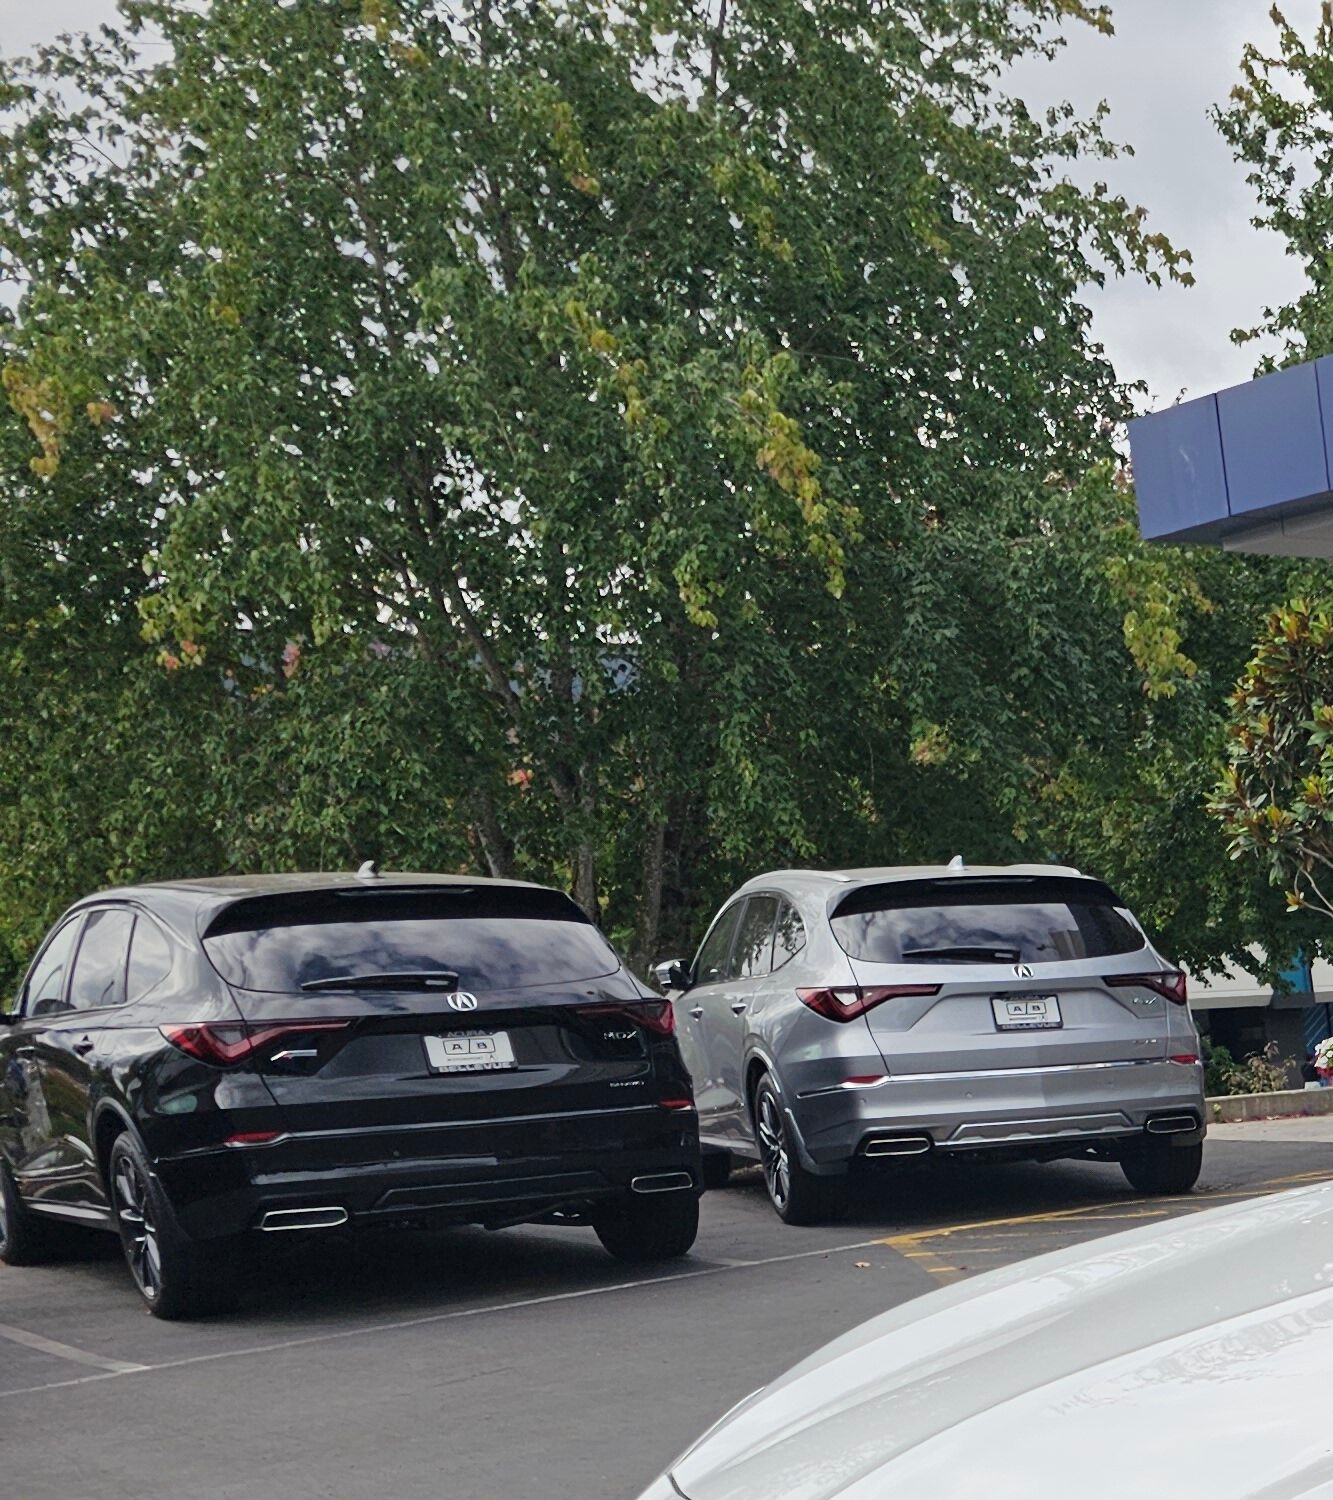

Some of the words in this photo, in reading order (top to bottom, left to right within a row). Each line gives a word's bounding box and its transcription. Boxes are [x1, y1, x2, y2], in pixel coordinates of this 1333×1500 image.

[452, 1043, 463, 1051] A
[477, 1042, 488, 1050] B
[438, 1062, 512, 1073] BELLEVUE
